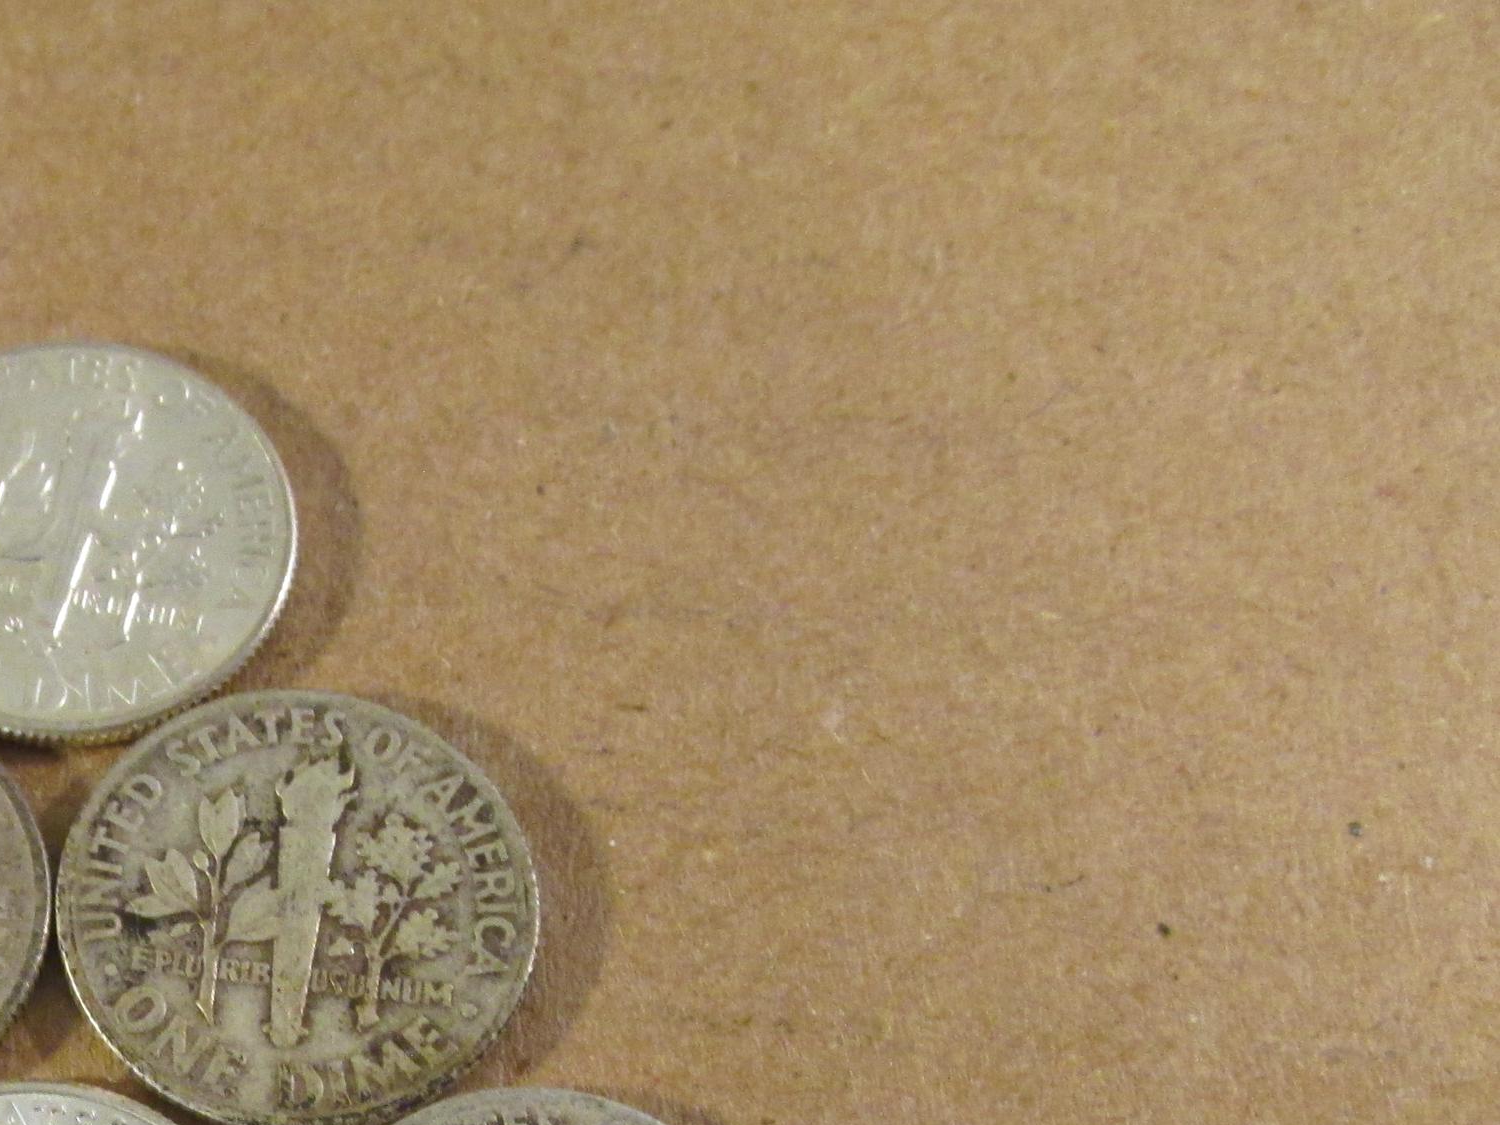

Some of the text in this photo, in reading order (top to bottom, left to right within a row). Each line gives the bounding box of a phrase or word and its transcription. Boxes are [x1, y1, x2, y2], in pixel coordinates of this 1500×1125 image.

[83, 774, 164, 941] UNITED
[166, 707, 346, 777] STATES
[365, 727, 434, 772] OF
[420, 773, 517, 976] AMERICA
[114, 986, 458, 1108] ONE DIME
